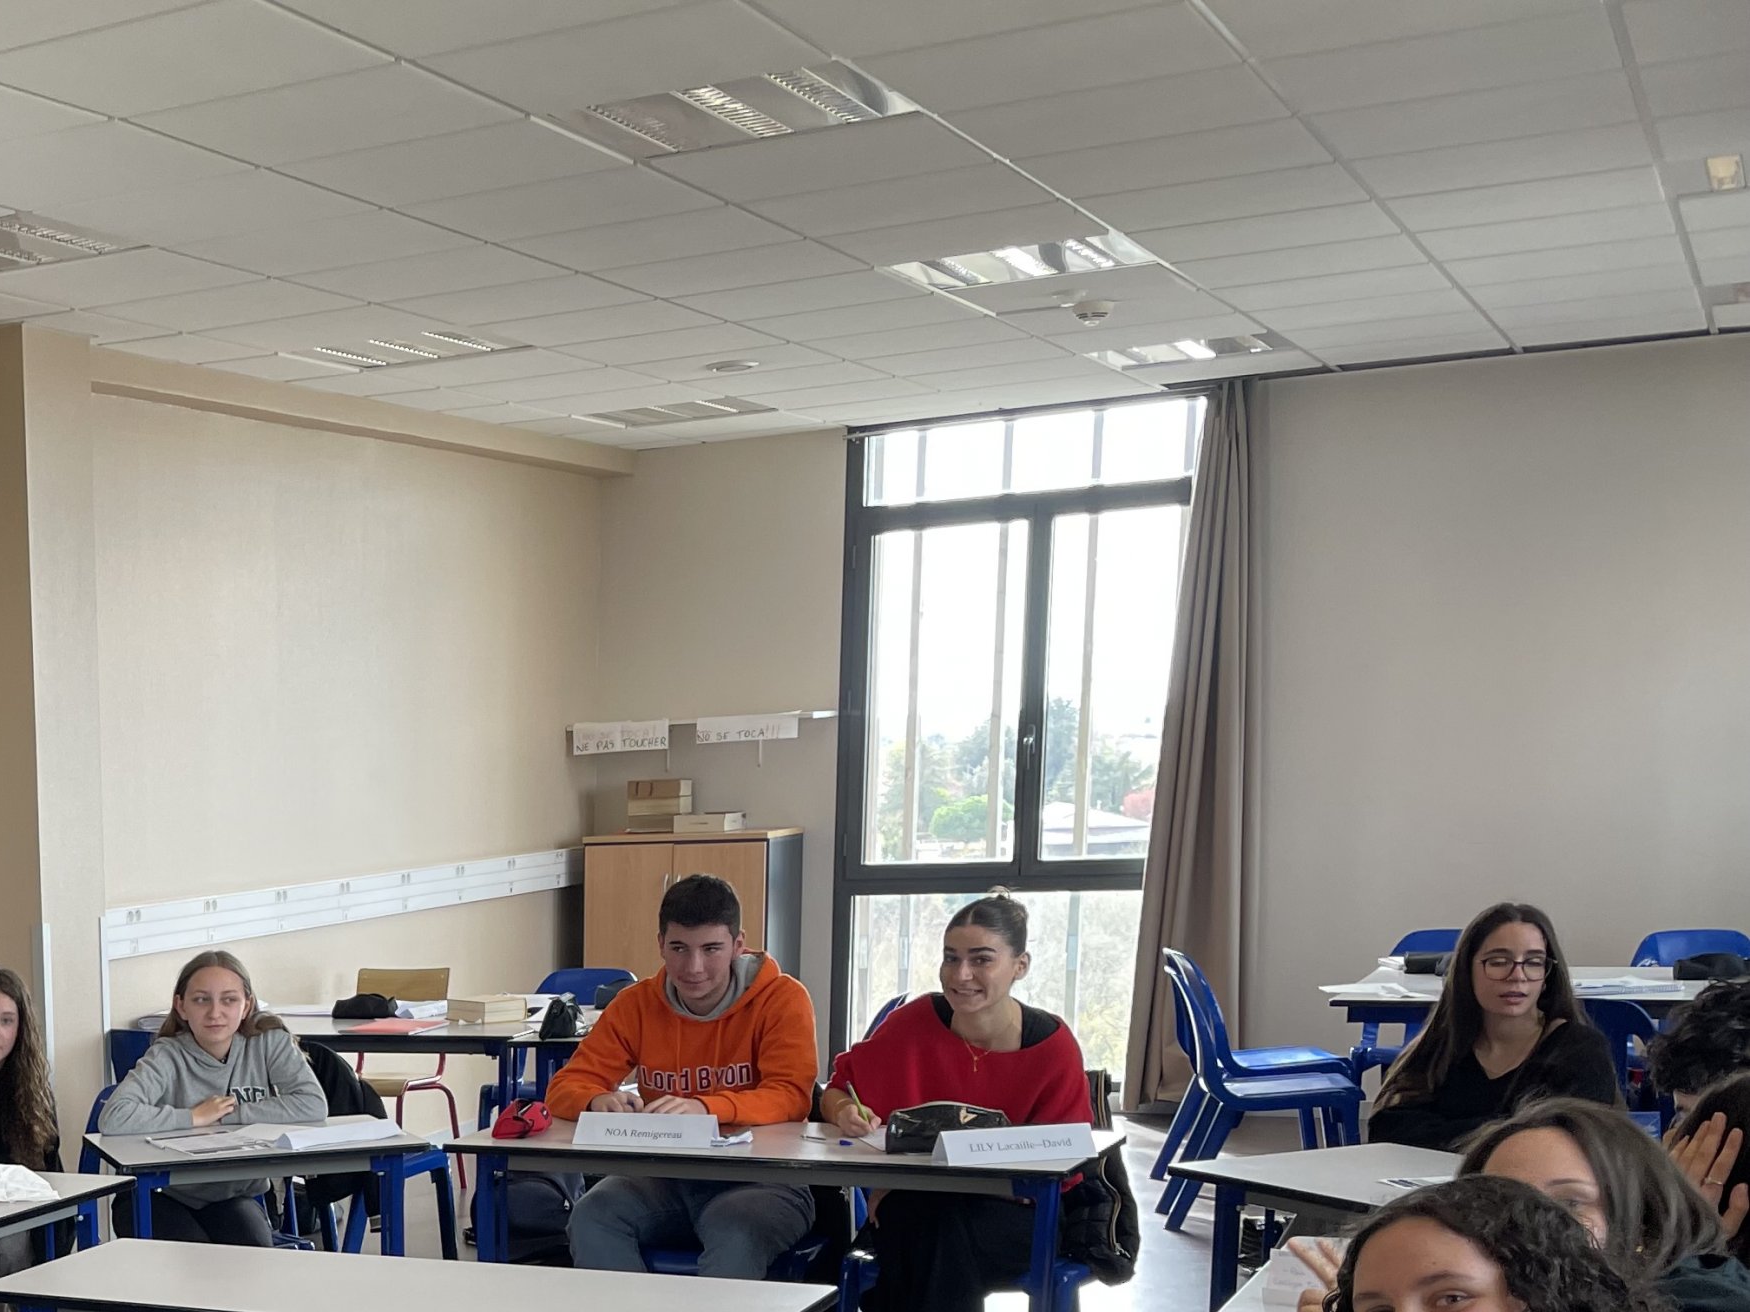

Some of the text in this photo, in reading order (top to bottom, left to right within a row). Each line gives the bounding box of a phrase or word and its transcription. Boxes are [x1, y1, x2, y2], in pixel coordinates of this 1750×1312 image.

[576, 736, 666, 752] NE PAS TOUCHER
[639, 1065, 690, 1093] Lord
[604, 1127, 683, 1140] NOA Remigereau
[969, 1142, 995, 1153] LILY
